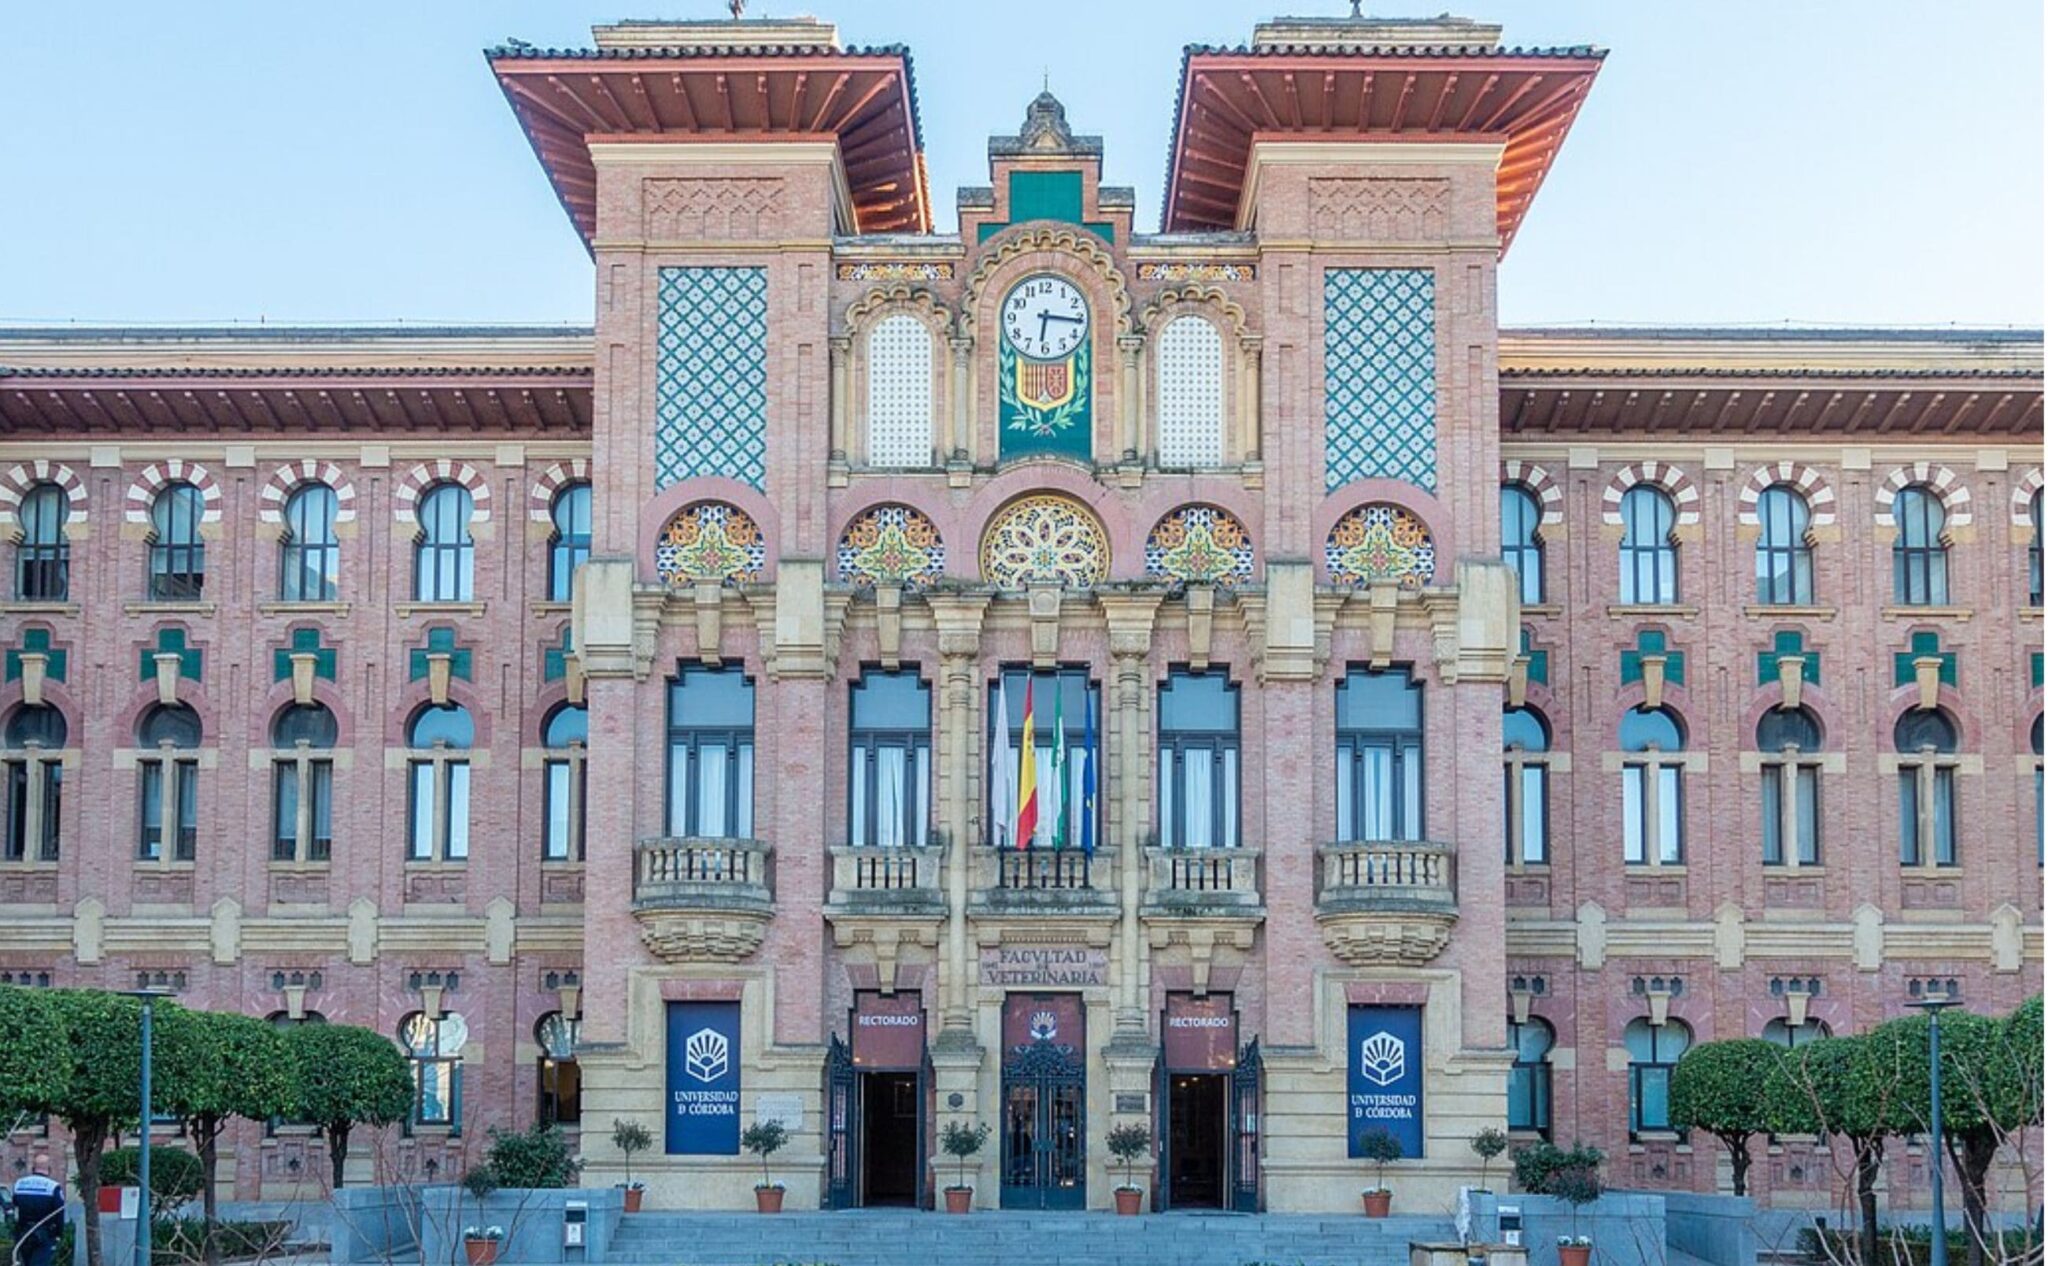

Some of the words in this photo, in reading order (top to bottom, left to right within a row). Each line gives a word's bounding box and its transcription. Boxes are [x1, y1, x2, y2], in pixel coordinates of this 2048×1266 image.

[1025, 285, 1035, 298] 11
[1039, 281, 1053, 294] 12
[1060, 287, 1066, 299] 1
[1013, 298, 1026, 310] 10
[1070, 297, 1079, 309] 2
[1007, 312, 1017, 324] 9
[1013, 327, 1021, 340] 8
[1069, 328, 1079, 340] 4
[1024, 337, 1032, 351] 7
[1041, 341, 1050, 354] 6
[1058, 337, 1066, 351] 5
[988, 970, 1099, 984] VETERINARIA
[858, 1015, 918, 1026] RECTORADO
[1169, 1017, 1229, 1028] RECTORADO
[674, 1090, 739, 1102] UNIVERSIDAD
[1351, 1094, 1416, 1106] UNIVERSIDAD
